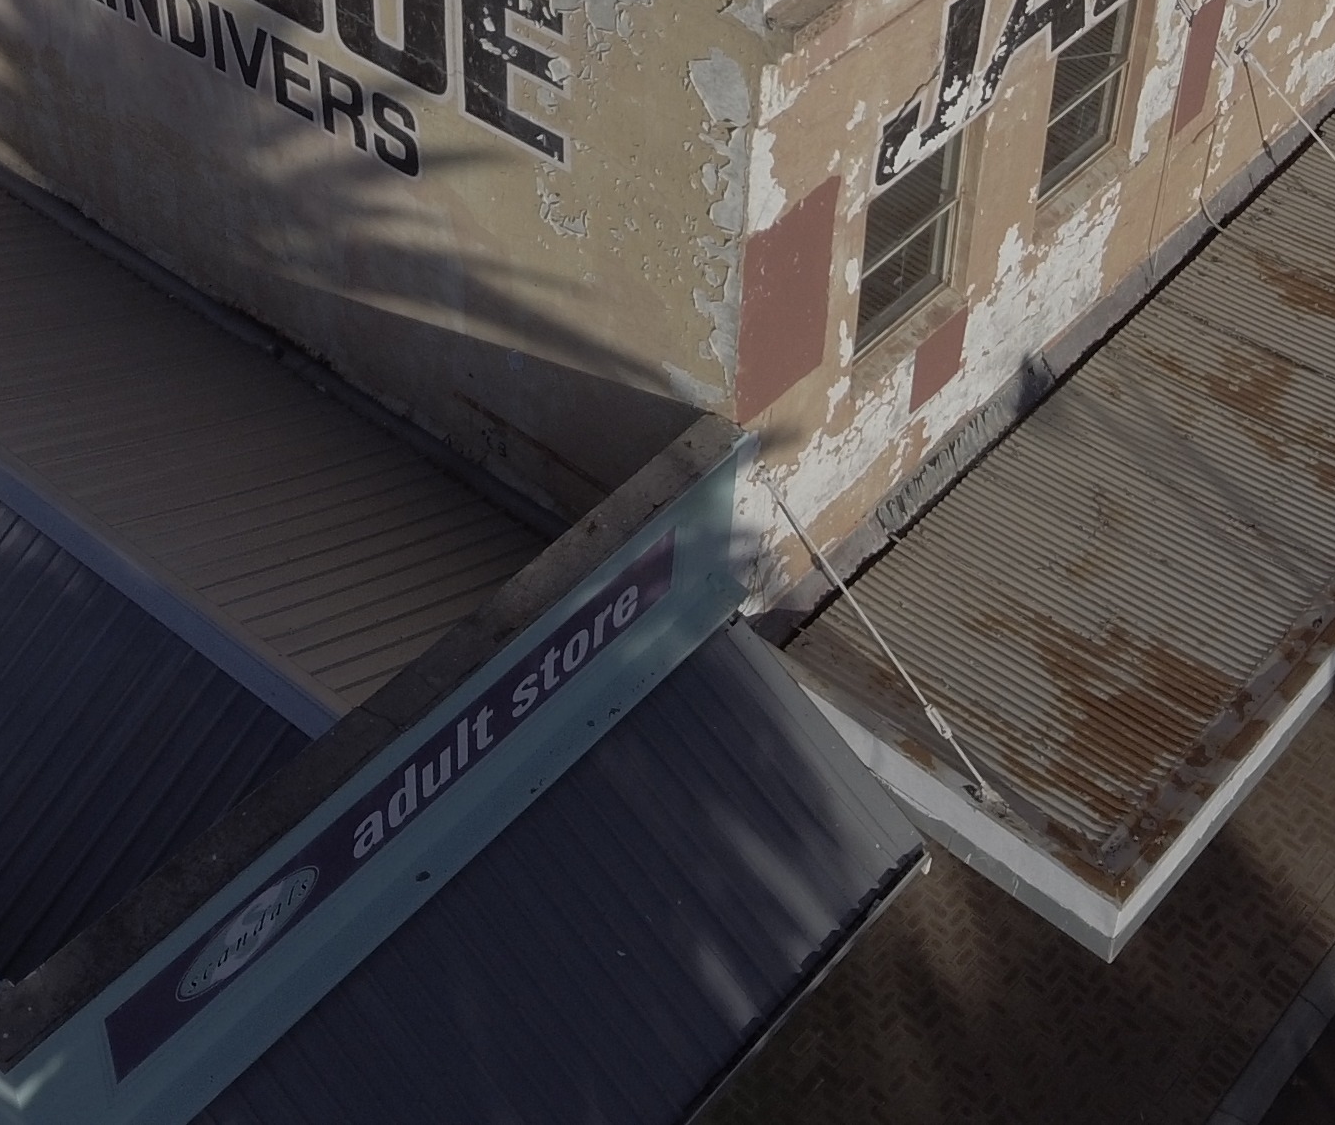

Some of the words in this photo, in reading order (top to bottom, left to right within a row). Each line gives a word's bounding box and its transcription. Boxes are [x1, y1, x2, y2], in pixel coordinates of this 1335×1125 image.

[353, 705, 494, 859] adult
[511, 585, 639, 718] store
[186, 879, 308, 994] scandals
